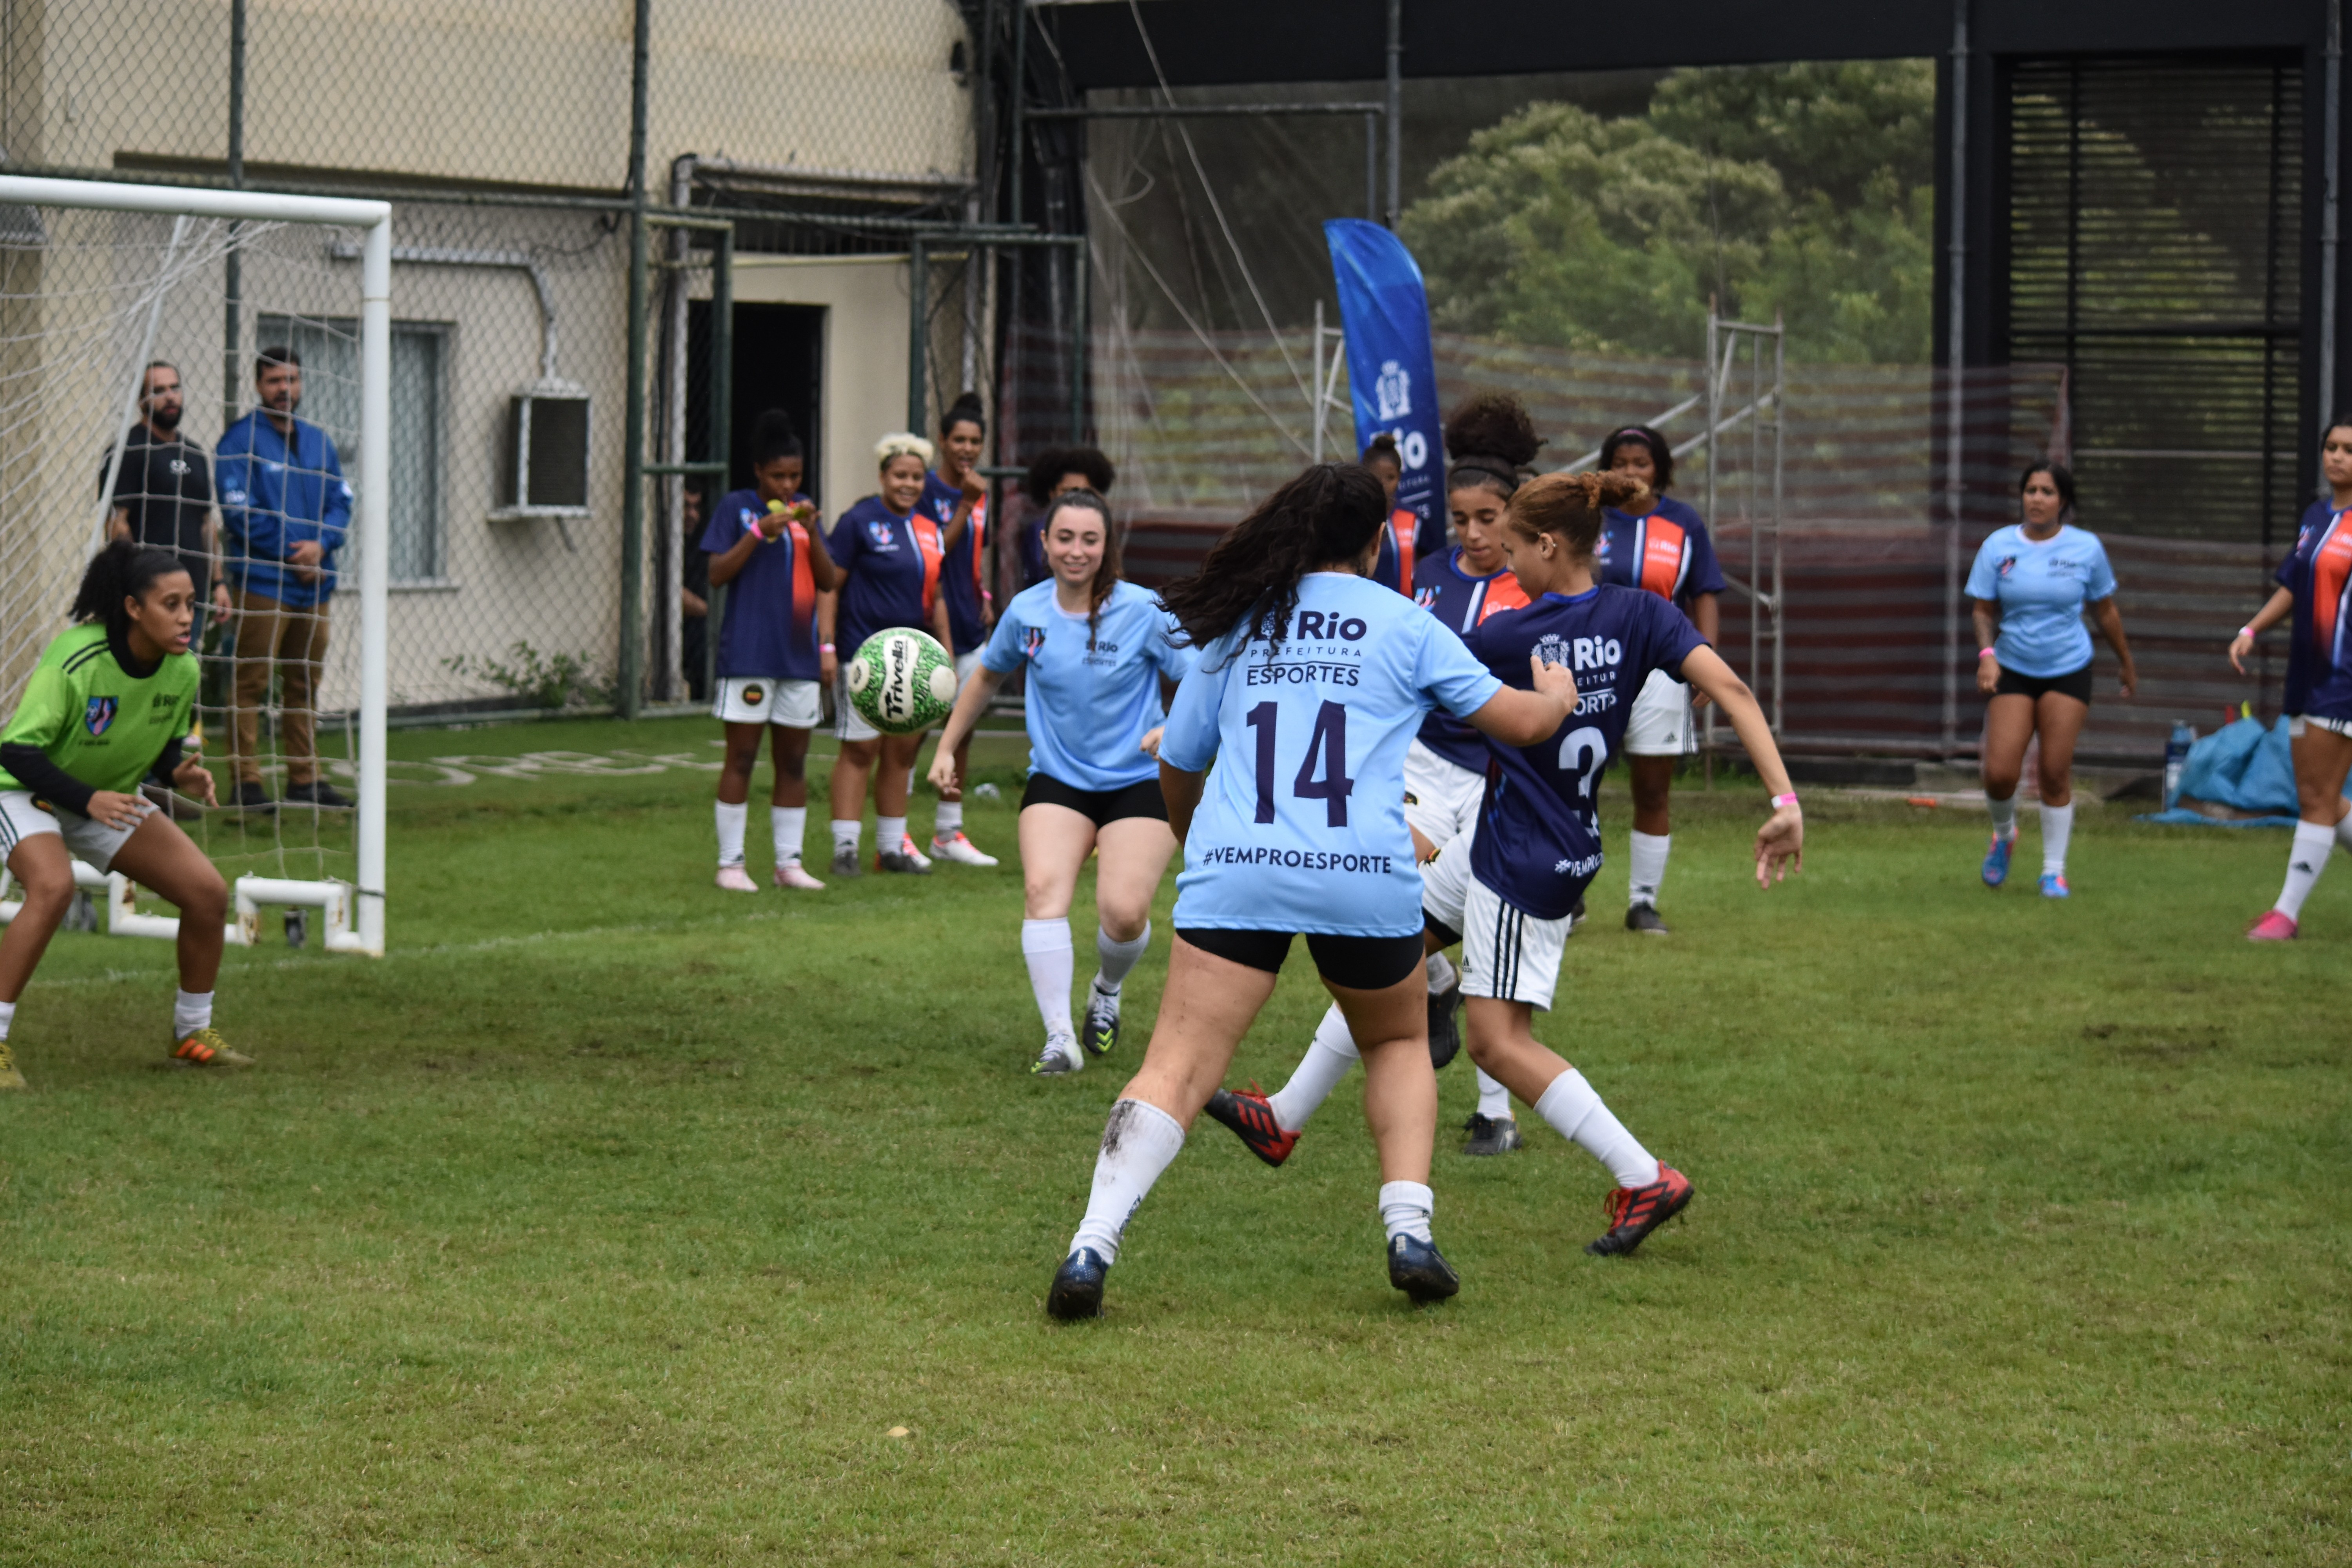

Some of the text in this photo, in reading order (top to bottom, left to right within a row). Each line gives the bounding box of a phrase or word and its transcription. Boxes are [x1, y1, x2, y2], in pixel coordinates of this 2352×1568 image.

[1369, 426, 1428, 473] io
[1297, 610, 1367, 641] Rio
[1098, 641, 1118, 652] Rio
[1574, 635, 1622, 670] Rio
[884, 640, 903, 719] Trivella
[1247, 665, 1359, 686] ESPORTES
[1577, 671, 1616, 686] EITUR
[1247, 699, 1354, 828] 14
[1203, 847, 1391, 874] #VEMPROESPORTE
[1555, 851, 1604, 877] #VEMPRO
